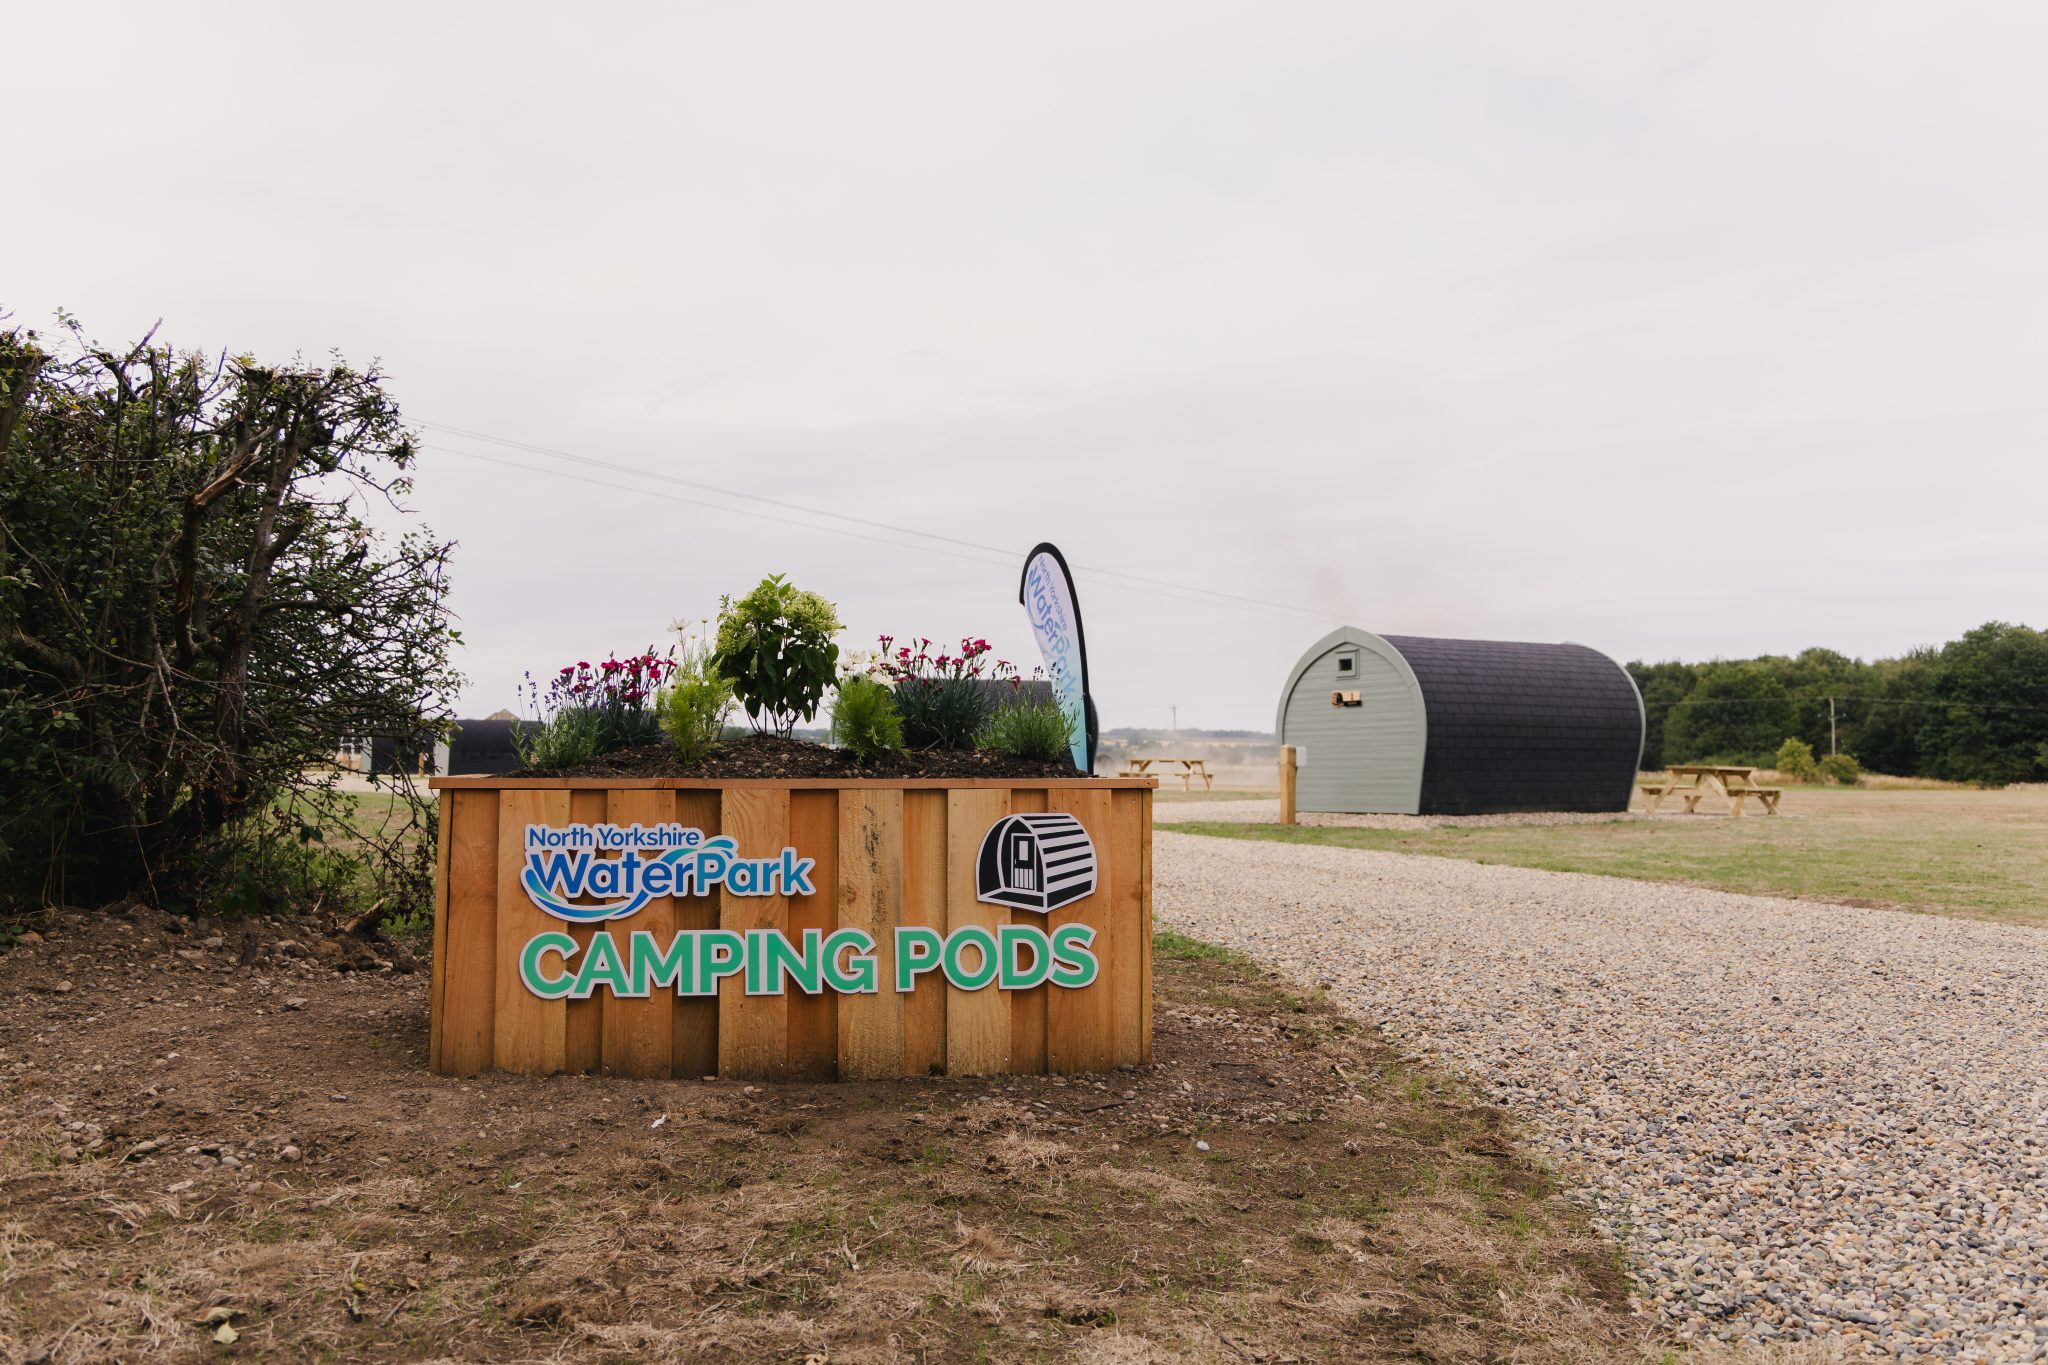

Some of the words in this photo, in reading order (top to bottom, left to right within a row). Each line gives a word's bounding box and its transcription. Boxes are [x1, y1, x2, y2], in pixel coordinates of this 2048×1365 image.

[529, 827, 593, 847] North
[597, 826, 700, 847] Yorkshire
[529, 850, 812, 895] WaterPark
[521, 930, 875, 996] CAMPING
[897, 926, 1096, 990] PODS
